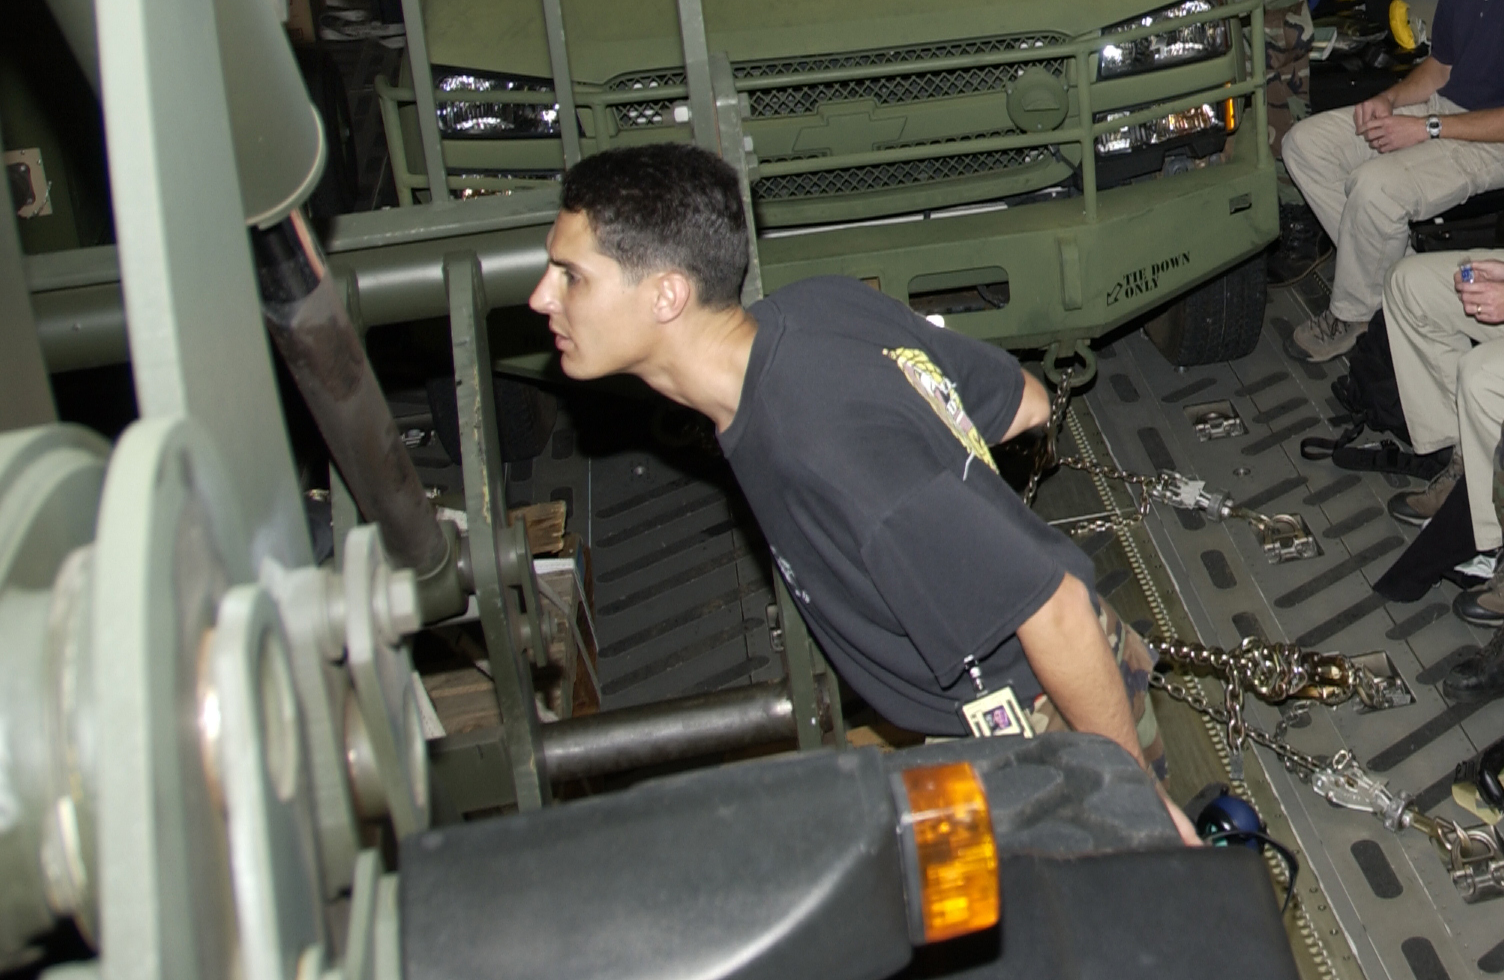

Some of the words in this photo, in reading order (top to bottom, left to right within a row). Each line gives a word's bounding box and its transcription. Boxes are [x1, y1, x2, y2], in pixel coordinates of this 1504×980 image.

[1122, 267, 1147, 286] TIE
[1151, 251, 1190, 276] DOWN
[1124, 274, 1160, 299] ONLY
